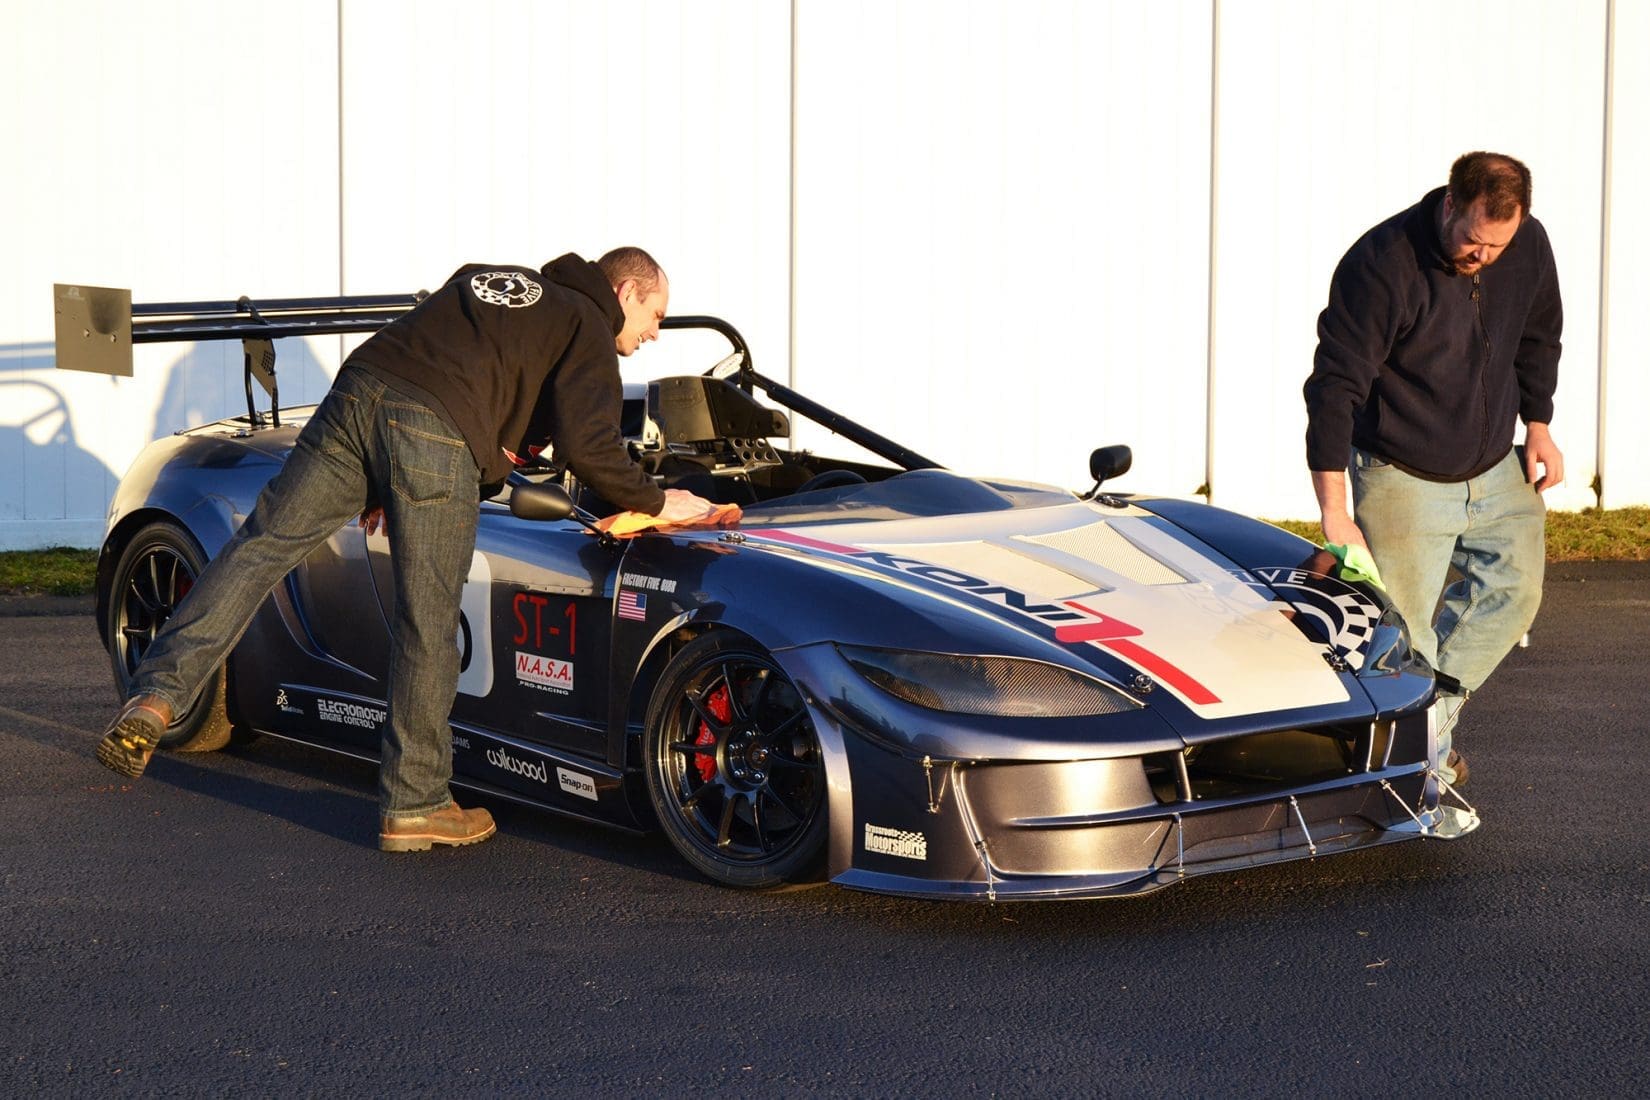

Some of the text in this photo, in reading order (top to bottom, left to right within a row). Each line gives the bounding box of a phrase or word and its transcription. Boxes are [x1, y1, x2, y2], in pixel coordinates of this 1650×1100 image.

[622, 573, 648, 588] FACTORY
[646, 576, 661, 590] FIVE
[850, 551, 1087, 621] KONI
[513, 593, 577, 656] ST-1
[517, 655, 571, 681] N.A.S.A.
[319, 711, 376, 730] ENGINE CONTROLS
[487, 747, 548, 784] wilwood
